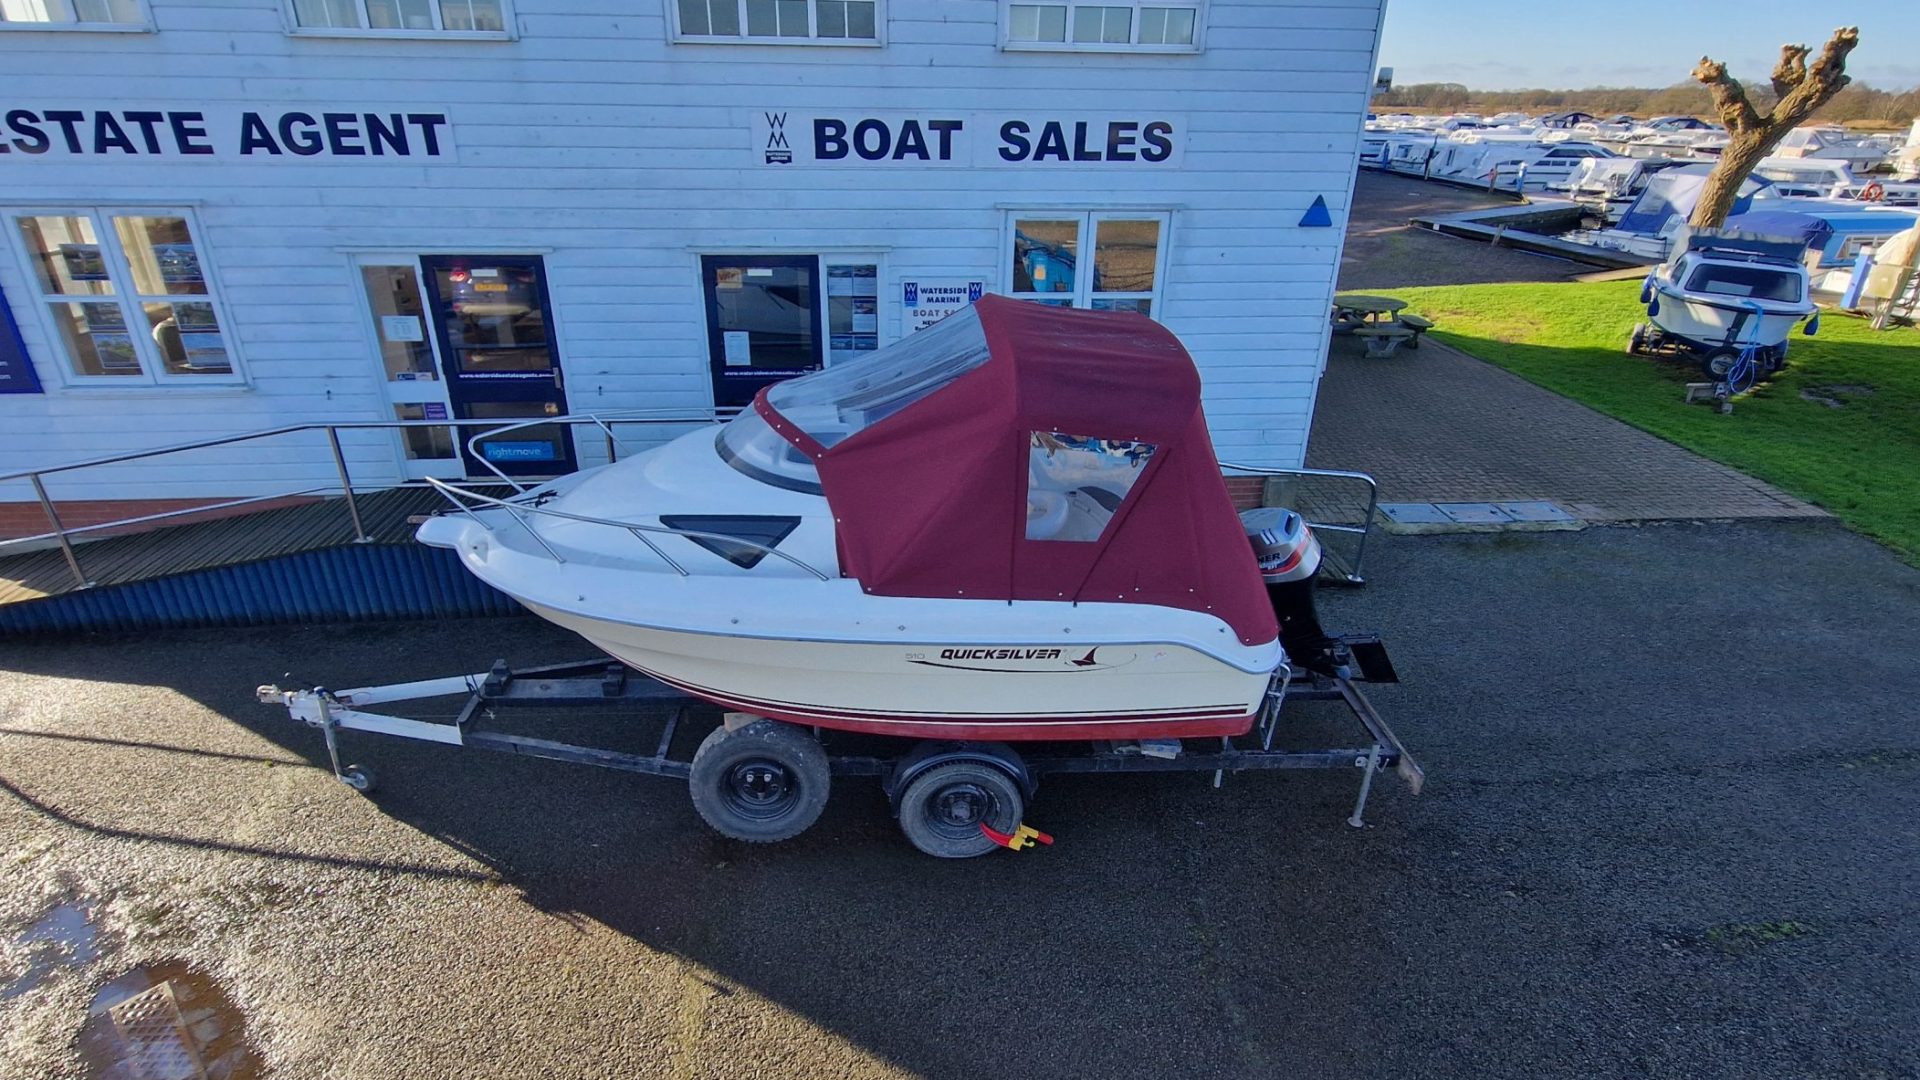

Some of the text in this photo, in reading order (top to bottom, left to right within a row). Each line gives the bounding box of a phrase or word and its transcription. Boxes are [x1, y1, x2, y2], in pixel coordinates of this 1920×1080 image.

[240, 112, 446, 156] AGENT
[813, 118, 1173, 163] BOAT SALES
[920, 287, 967, 295] WATERSIDE
[912, 309, 940, 317] BOAT
[488, 447, 542, 458] rightmove
[940, 648, 1062, 660] QUICKSILVER
